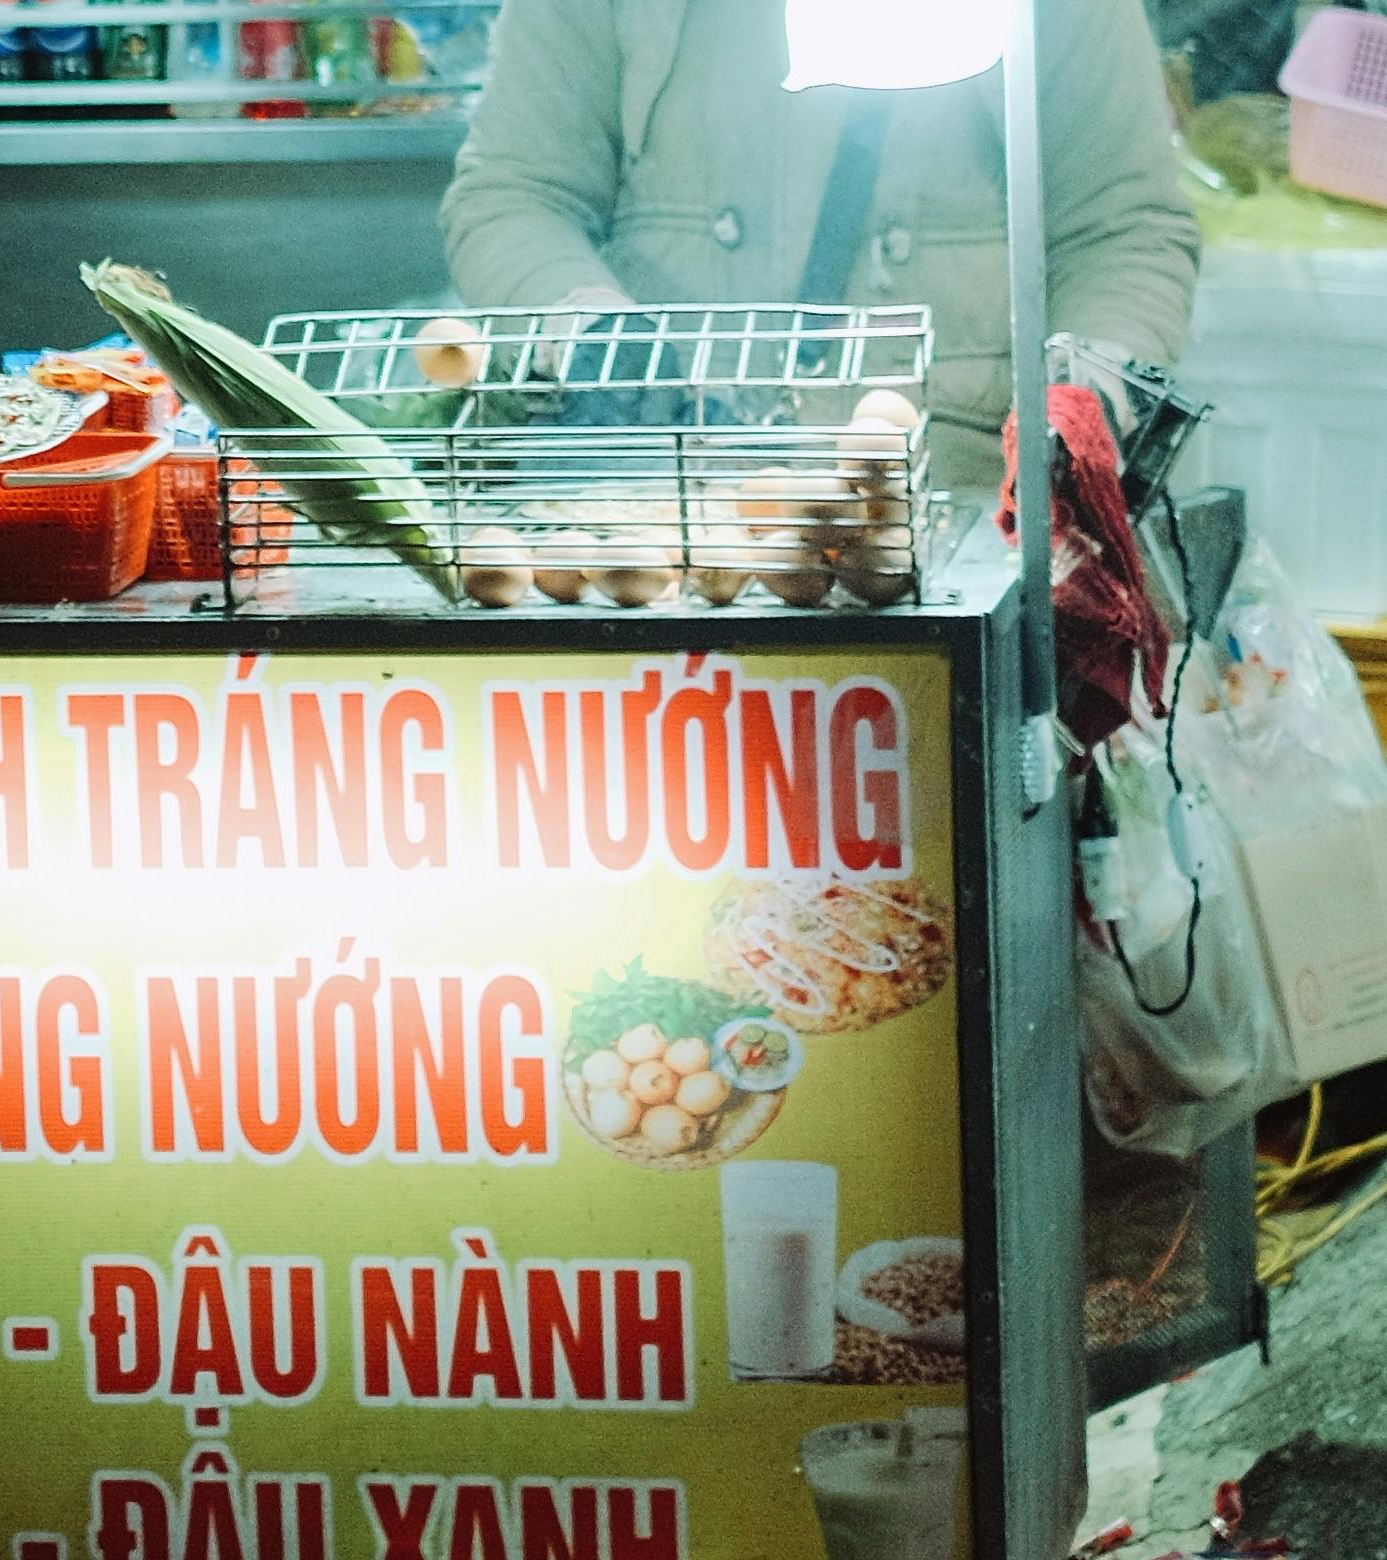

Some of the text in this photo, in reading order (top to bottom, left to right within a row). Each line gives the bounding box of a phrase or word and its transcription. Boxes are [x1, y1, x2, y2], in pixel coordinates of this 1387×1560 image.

[65, 651, 451, 873] TRÁNG
[491, 649, 907, 874] NƯỚNG
[147, 936, 551, 1160] NƯỚNG
[87, 1235, 322, 1430] ĐẬU
[359, 1236, 688, 1403] NÀNH
